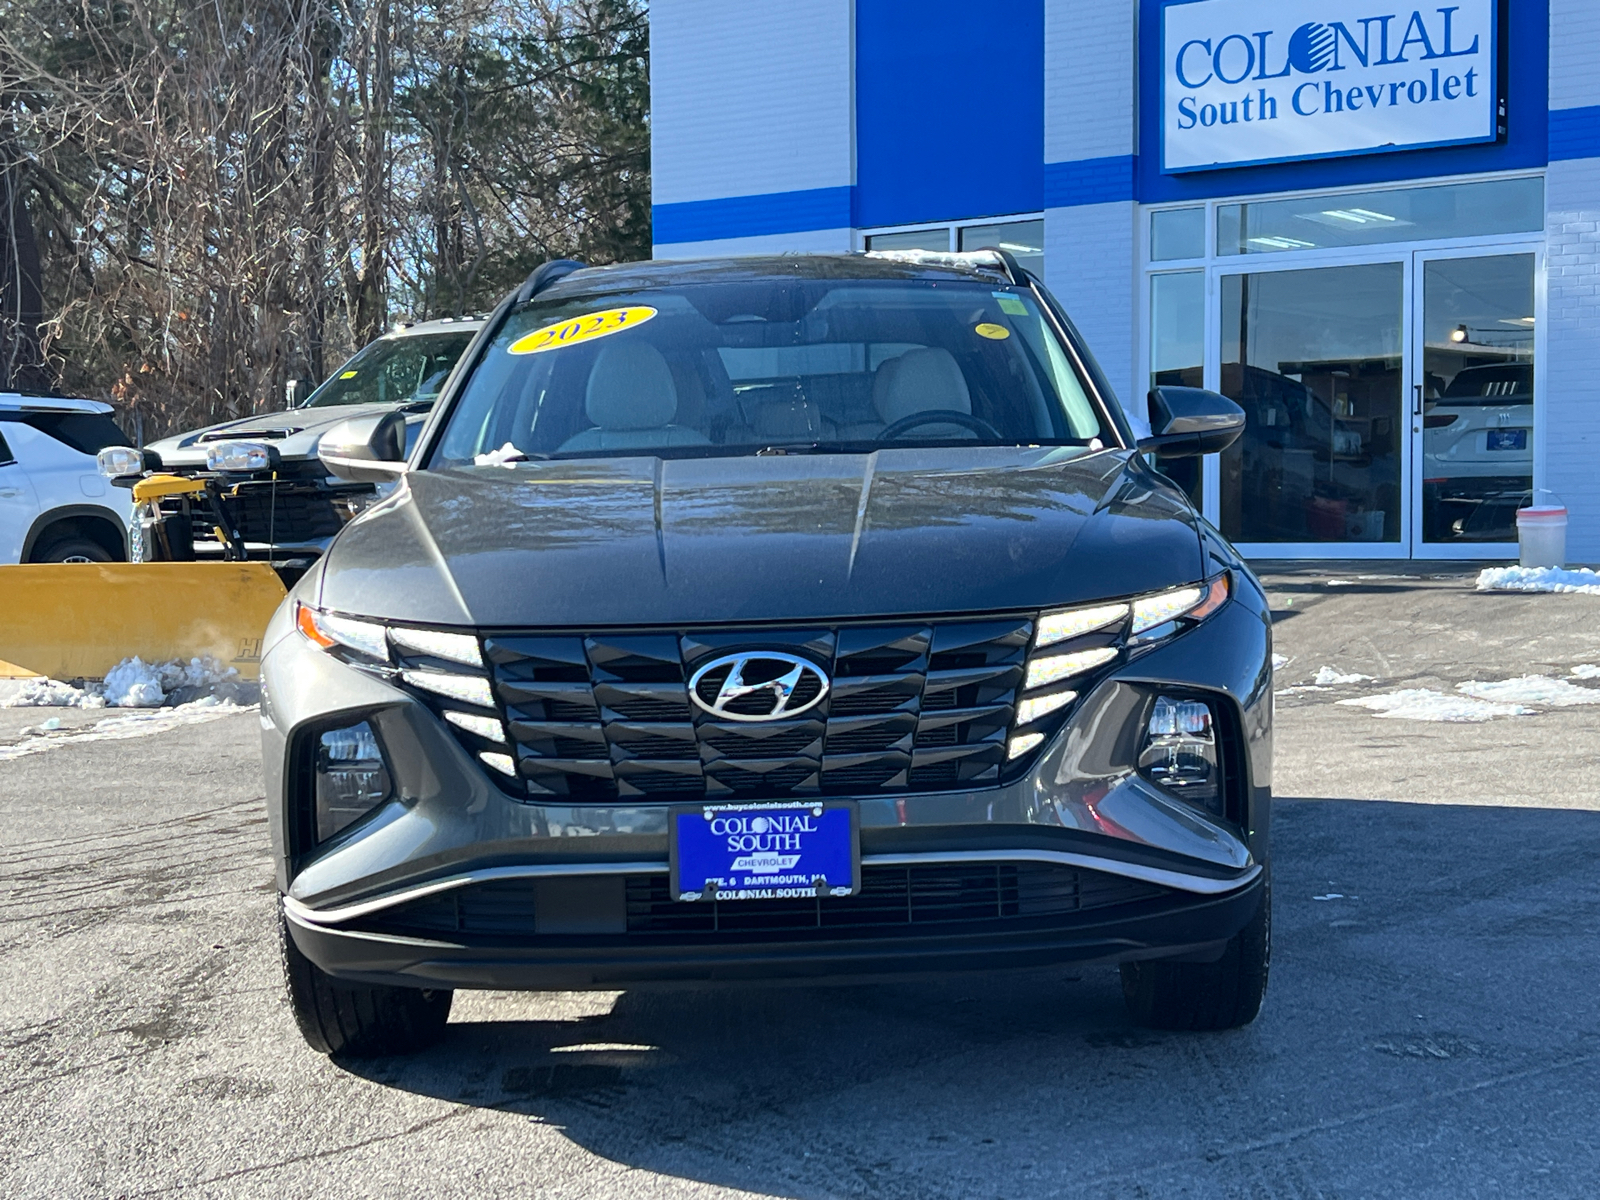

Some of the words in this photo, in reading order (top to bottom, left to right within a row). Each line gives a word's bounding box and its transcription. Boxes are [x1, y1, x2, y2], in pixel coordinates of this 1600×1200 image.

[1175, 6, 1479, 89] COLONIAL
[1177, 88, 1277, 129] South
[1291, 66, 1478, 116] Chevrolet
[534, 311, 628, 349] 2023
[702, 801, 823, 812] www.buycolonialsouth.com
[710, 815, 818, 836] COLONIAL
[727, 833, 802, 852] SOUTH
[737, 857, 794, 868] CHEVROLET
[729, 876, 737, 886] 6
[743, 874, 809, 886] DARTMOUTH,
[715, 888, 775, 900] COLONIAL
[776, 887, 817, 899] SOUTH
